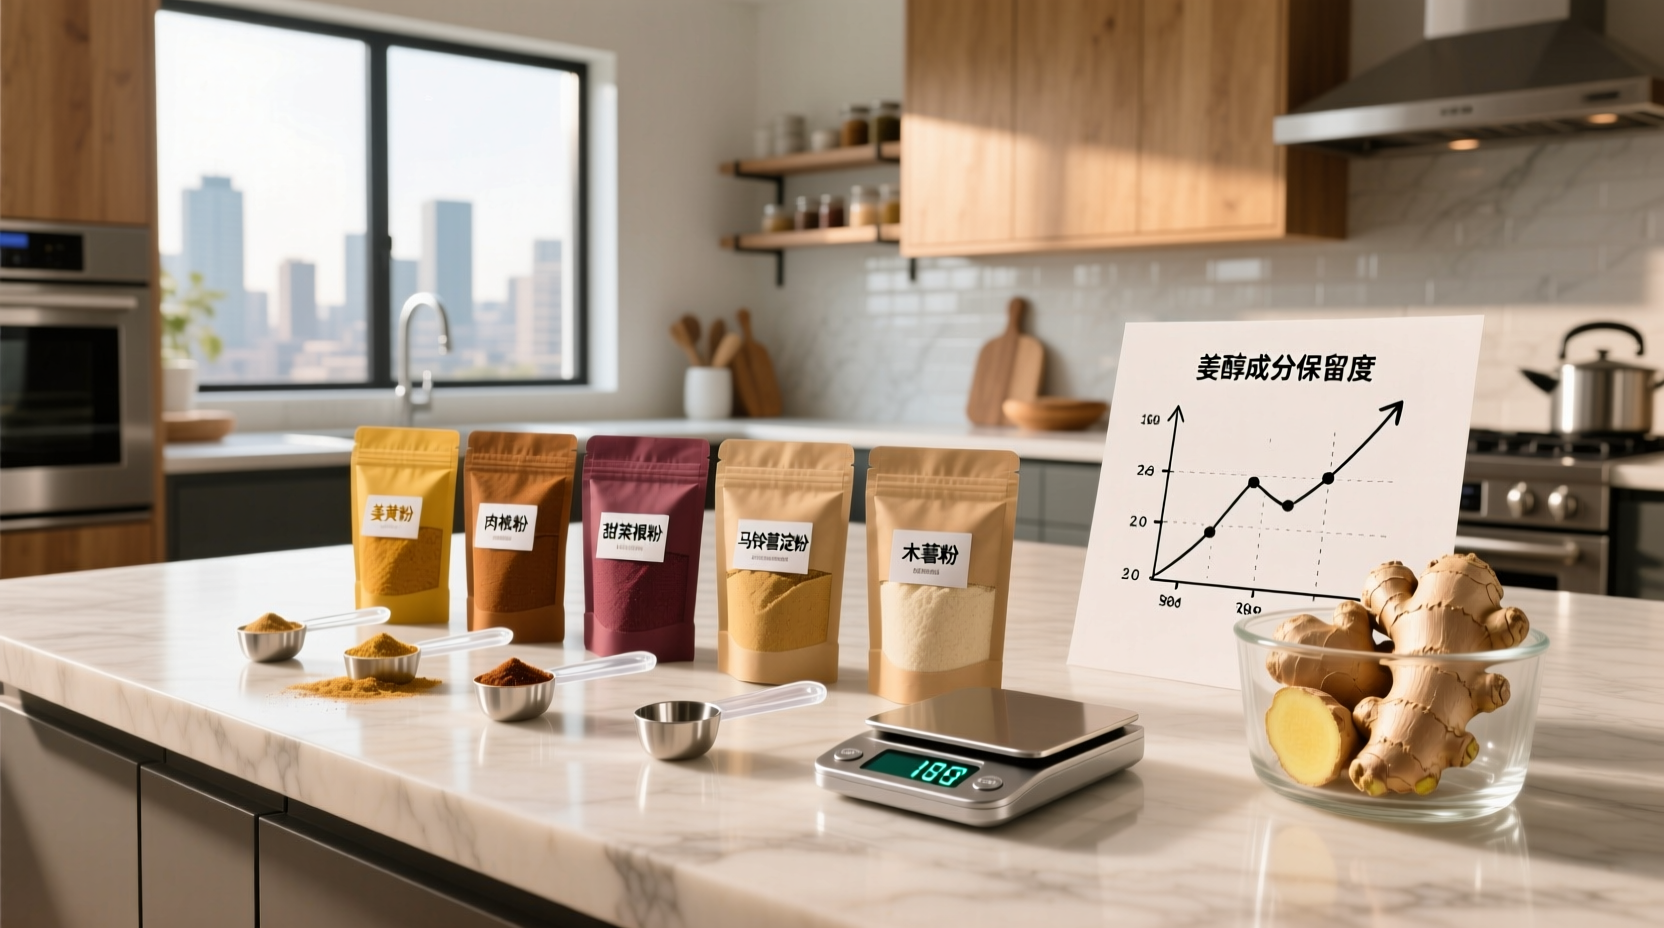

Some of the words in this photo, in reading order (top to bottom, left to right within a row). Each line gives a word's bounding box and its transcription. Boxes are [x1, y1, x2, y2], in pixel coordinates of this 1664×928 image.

[1196, 353, 1377, 382] 姜醇成分保留度
[1129, 515, 1148, 528] 20
[901, 542, 959, 566] 木薯粉
